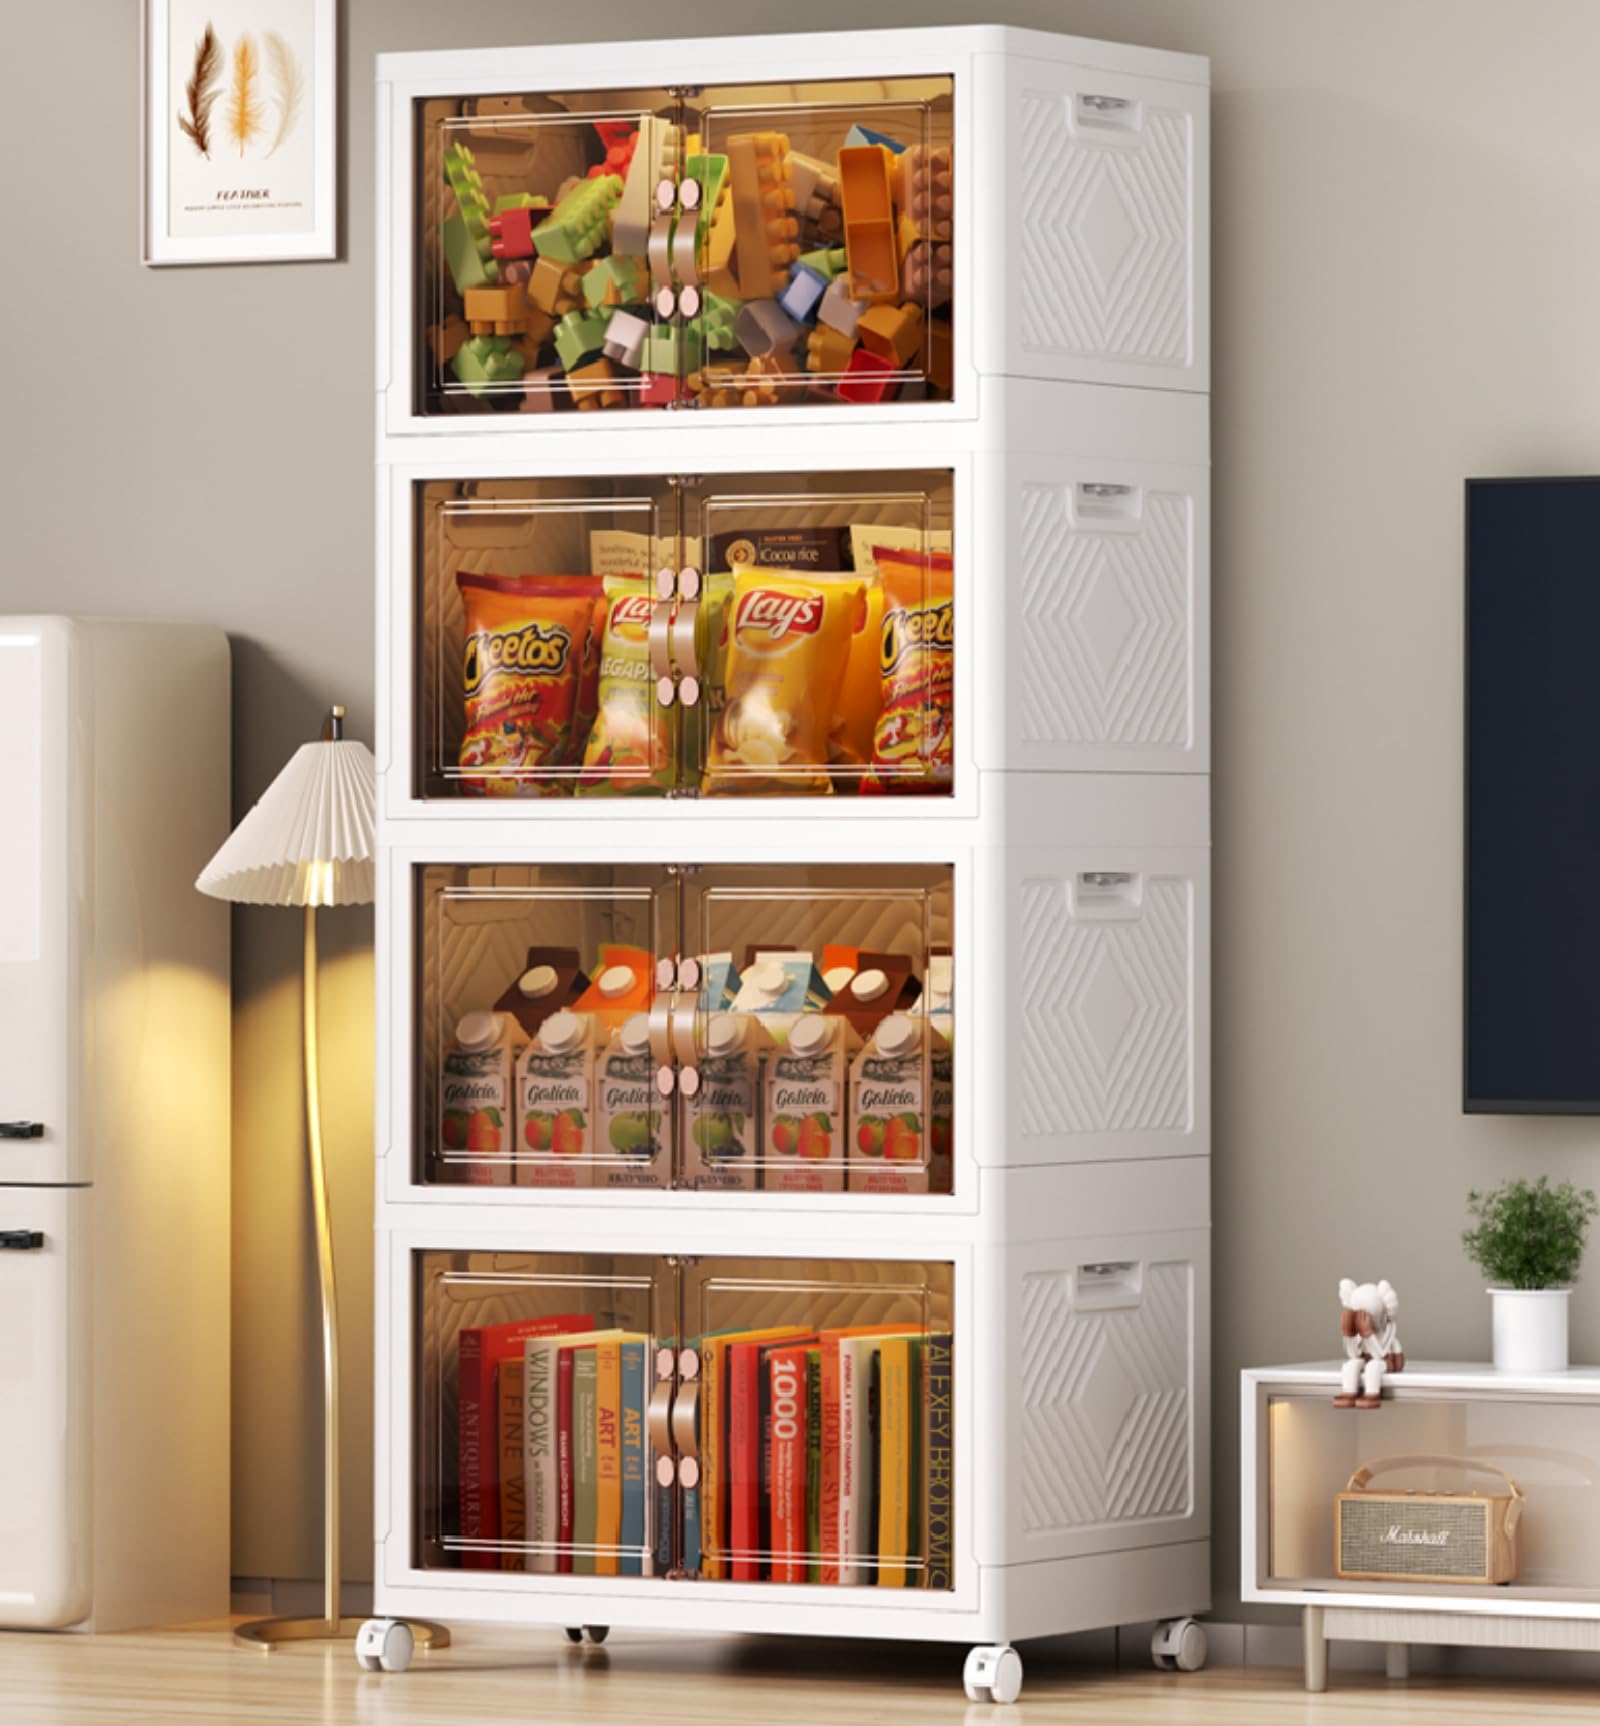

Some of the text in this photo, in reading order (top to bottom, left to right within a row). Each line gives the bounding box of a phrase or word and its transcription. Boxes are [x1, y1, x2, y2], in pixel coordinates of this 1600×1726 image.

[614, 597, 657, 632] Lay
[464, 626, 566, 692] Cheetos
[527, 1084, 580, 1106] Galicia
[776, 1087, 828, 1108] Galicia
[862, 1088, 917, 1109] Galicia
[528, 1349, 550, 1457] WINDOWS
[774, 1359, 797, 1439] 1000
[599, 1407, 616, 1448] ART
[624, 1408, 641, 1449] ART
[824, 1402, 839, 1458] BOOK
[843, 1408, 852, 1442] WORLD
[463, 1400, 481, 1537] ANTIQUAIRES
[503, 1393, 525, 1571] FINE WINS
[824, 1481, 839, 1582] SYMBOS
[1379, 1524, 1450, 1546] Marshall
